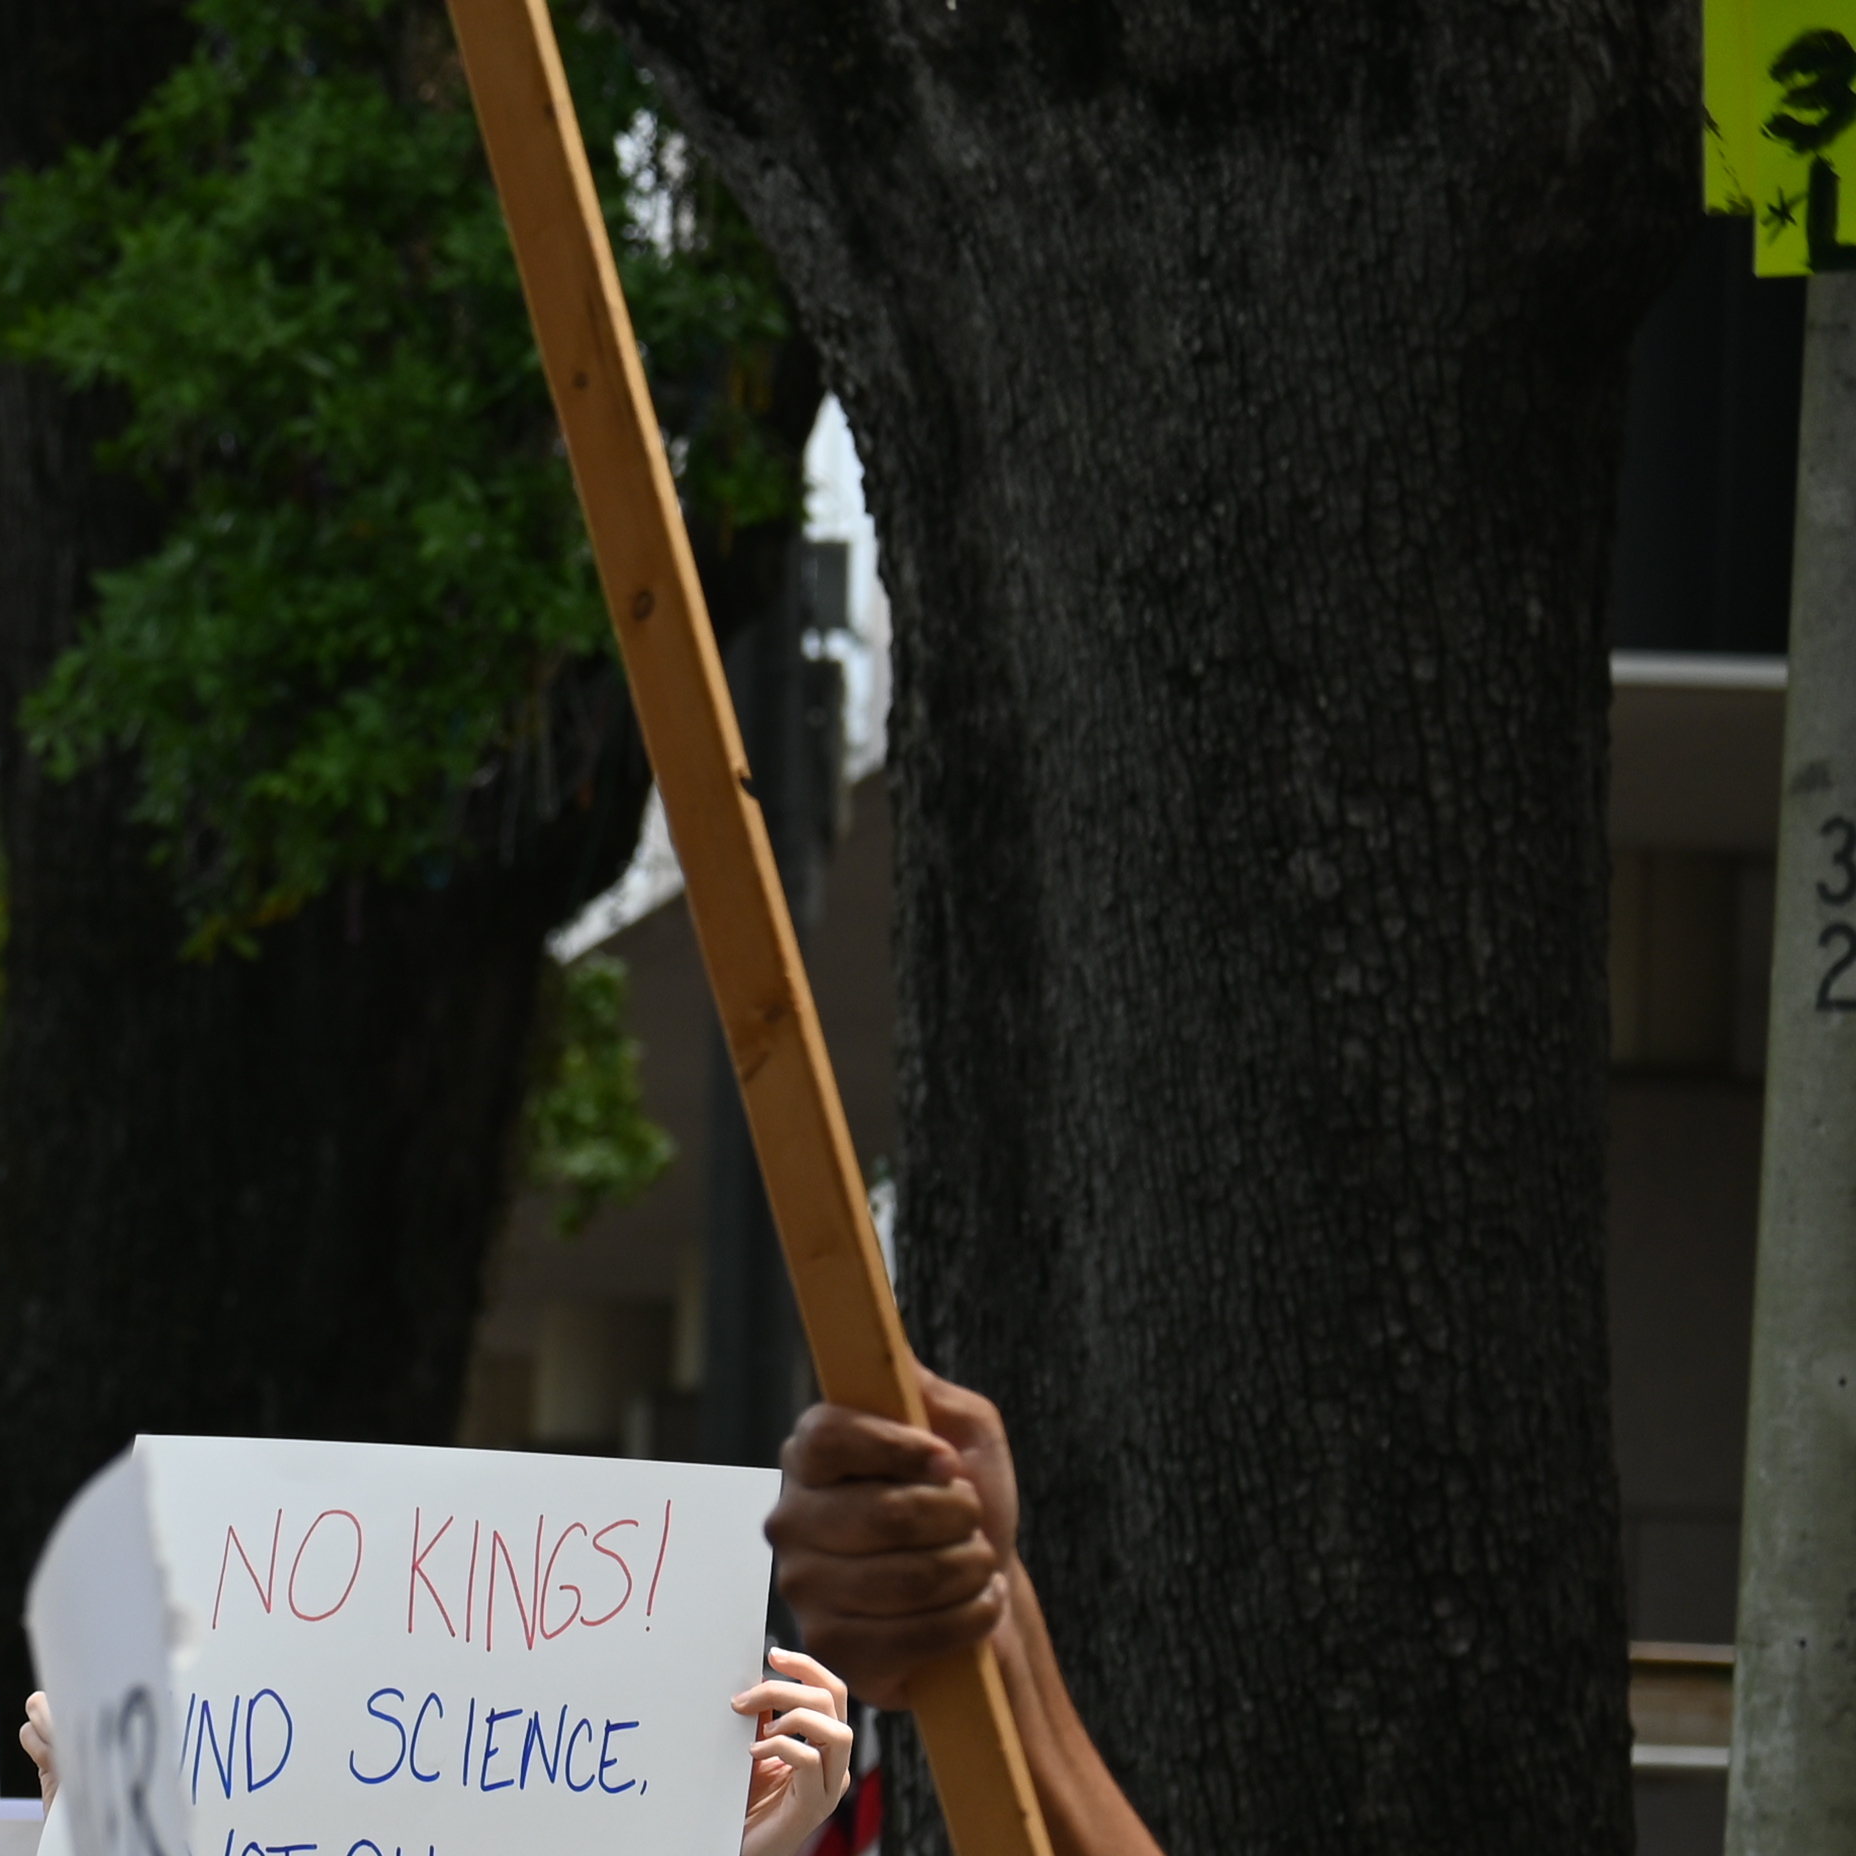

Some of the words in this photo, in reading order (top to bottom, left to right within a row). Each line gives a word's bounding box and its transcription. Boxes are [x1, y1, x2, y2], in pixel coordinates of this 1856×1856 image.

[209, 1504, 365, 1632] NO
[404, 1497, 674, 1654] KINGS!
[348, 1685, 651, 1799] SCIENCE,
